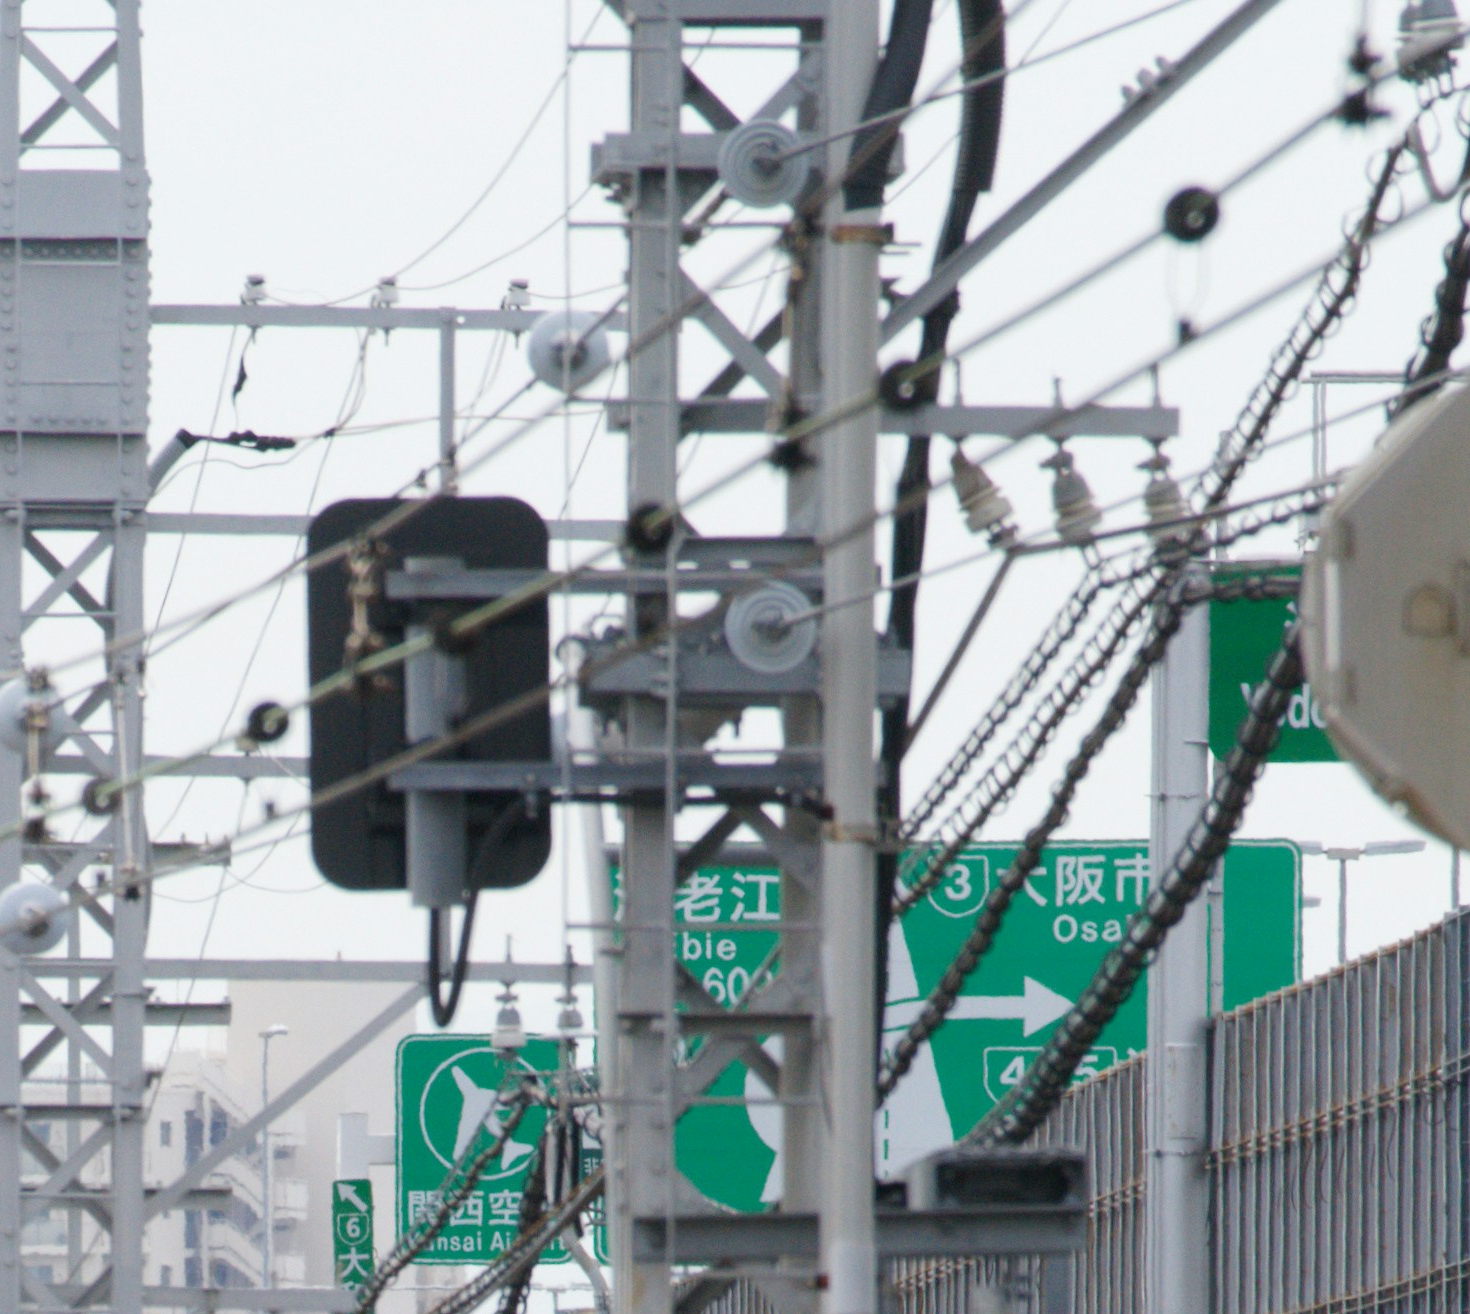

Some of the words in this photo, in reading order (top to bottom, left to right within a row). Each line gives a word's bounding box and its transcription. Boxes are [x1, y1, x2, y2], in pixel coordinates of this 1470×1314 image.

[613, 872, 780, 923] 老江
[945, 864, 972, 900] 3
[674, 931, 736, 960] bie
[408, 1189, 524, 1227] 関西空
[347, 1217, 360, 1238] 6
